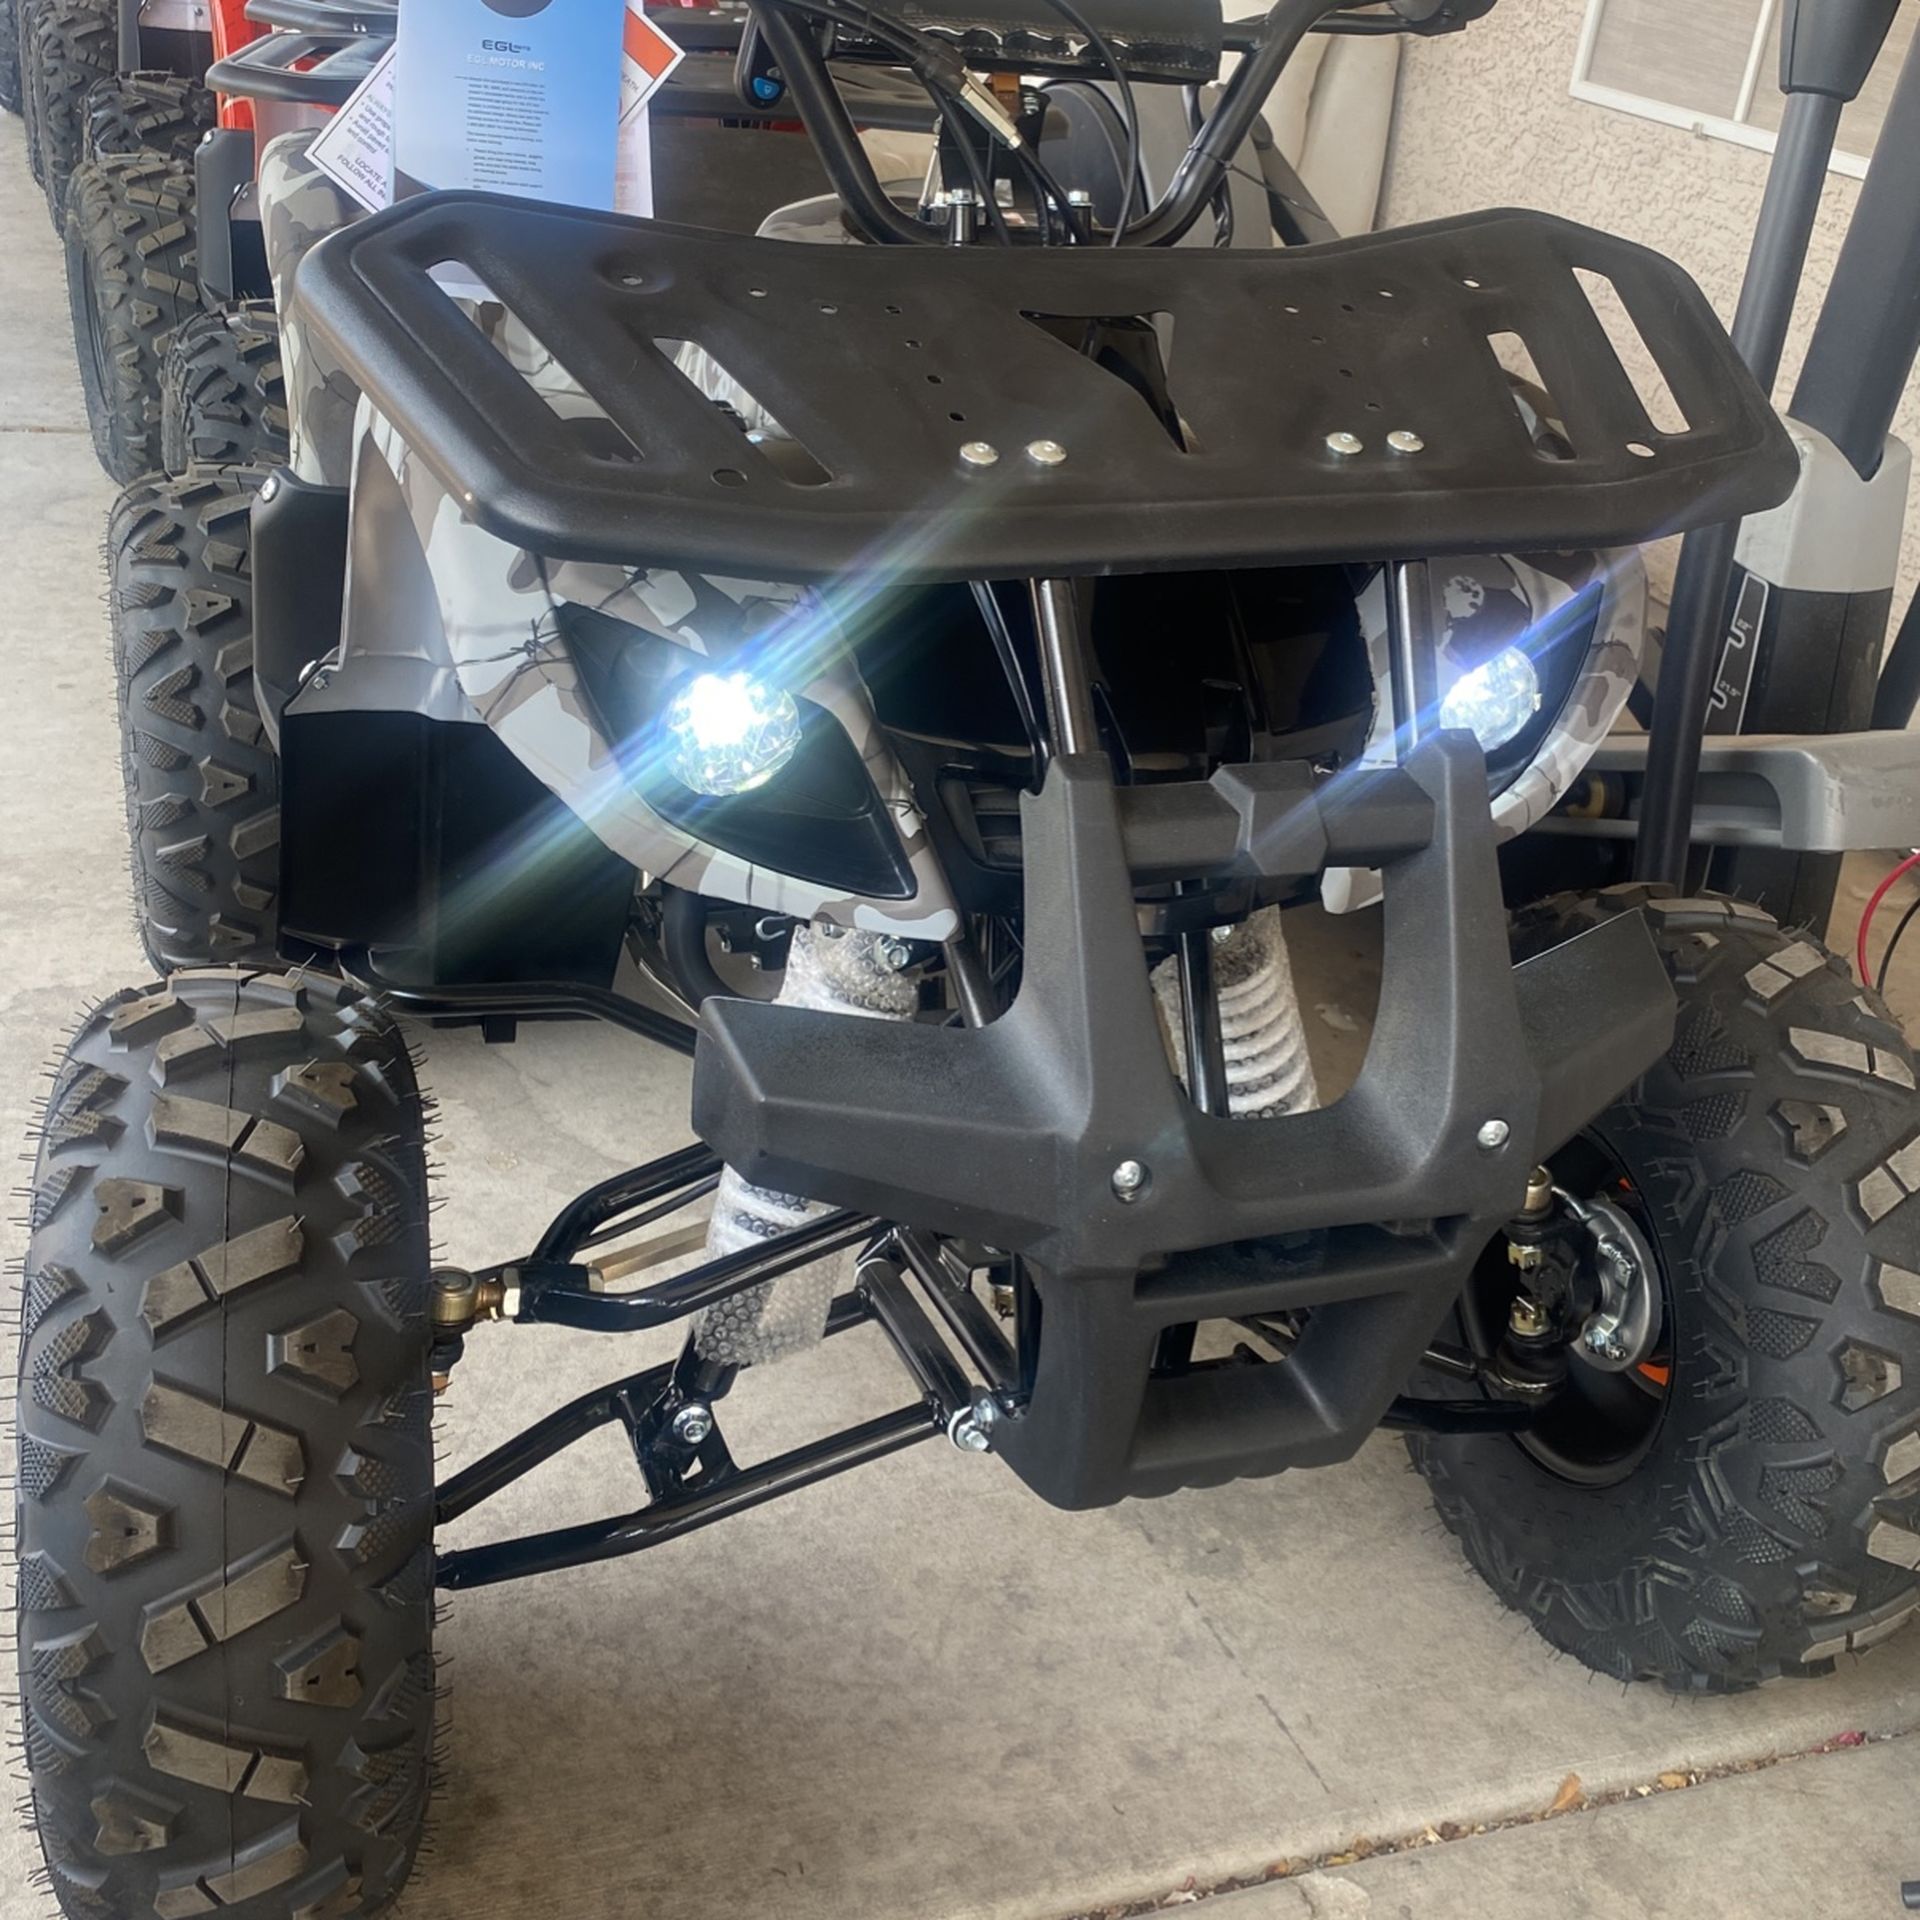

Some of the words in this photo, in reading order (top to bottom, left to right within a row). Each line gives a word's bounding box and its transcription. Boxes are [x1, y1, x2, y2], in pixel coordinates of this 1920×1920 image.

[482, 39, 520, 53] EGL
[490, 56, 526, 69] MOTOR
[528, 61, 545, 72] INC
[337, 154, 367, 181] FOLLOW
[364, 179, 378, 192] ALL
[355, 157, 384, 183] LOCATE
